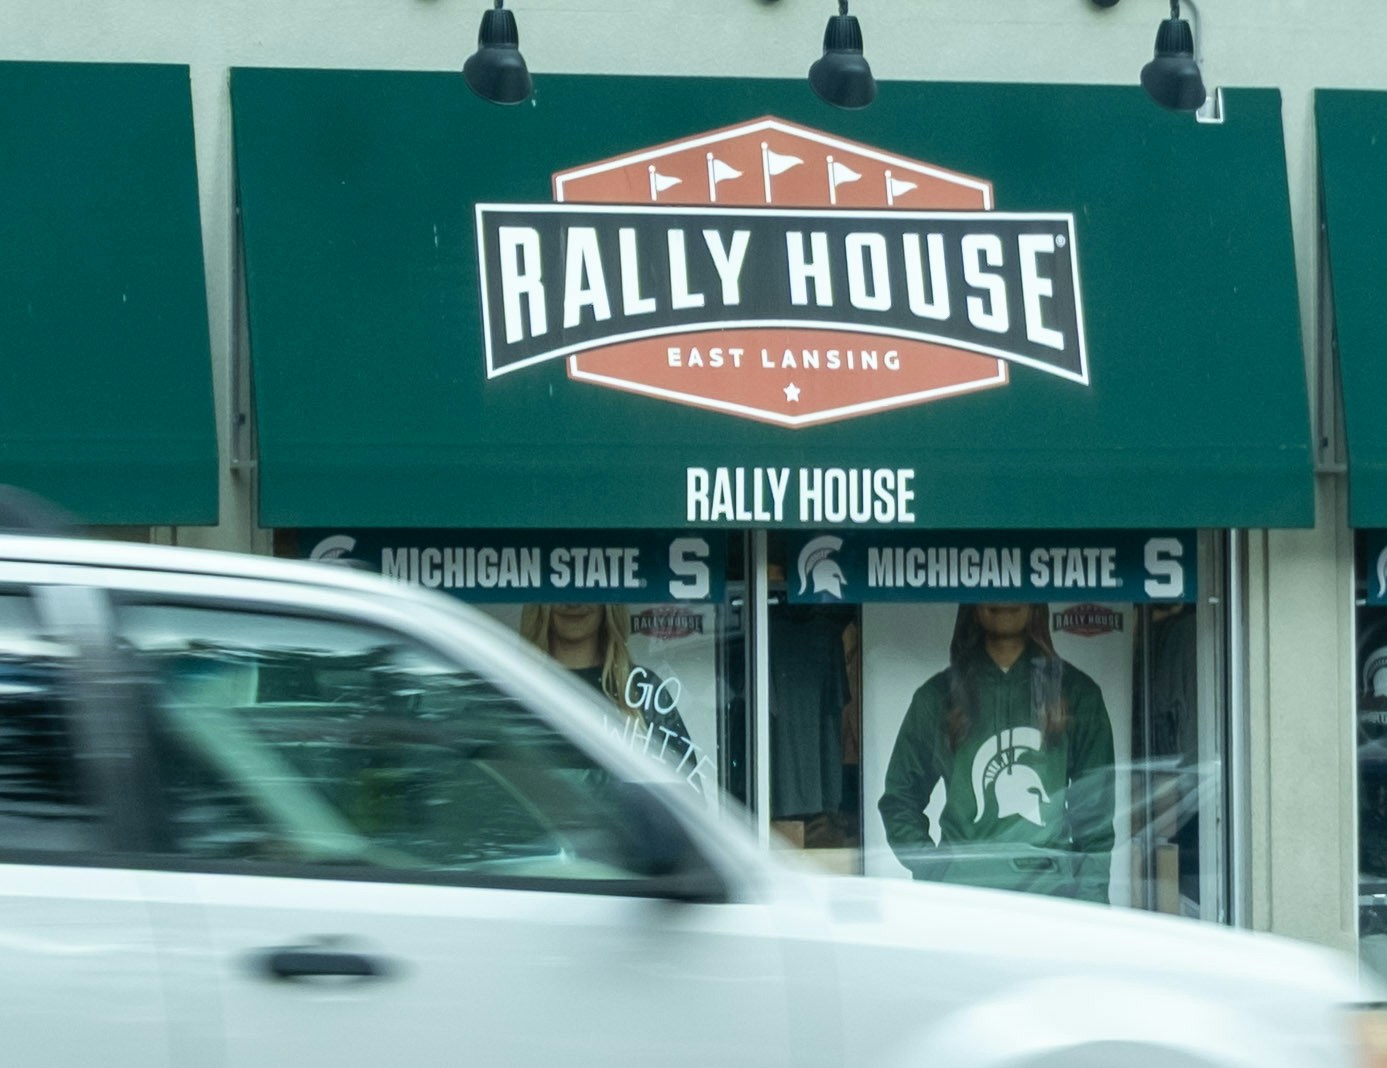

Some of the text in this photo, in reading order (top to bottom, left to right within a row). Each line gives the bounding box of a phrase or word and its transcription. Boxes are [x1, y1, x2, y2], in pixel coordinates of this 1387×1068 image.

[498, 226, 751, 345] RALLY
[667, 347, 902, 372] EAST LANSING
[686, 467, 916, 523] RALLY HOUSE
[381, 547, 541, 588] MICHIGAN
[550, 547, 642, 588] STATE
[867, 547, 1022, 588] MICHIGAN
[1030, 548, 1117, 588] STATE
[625, 667, 681, 714] GO
[602, 714, 717, 793] WHITE
